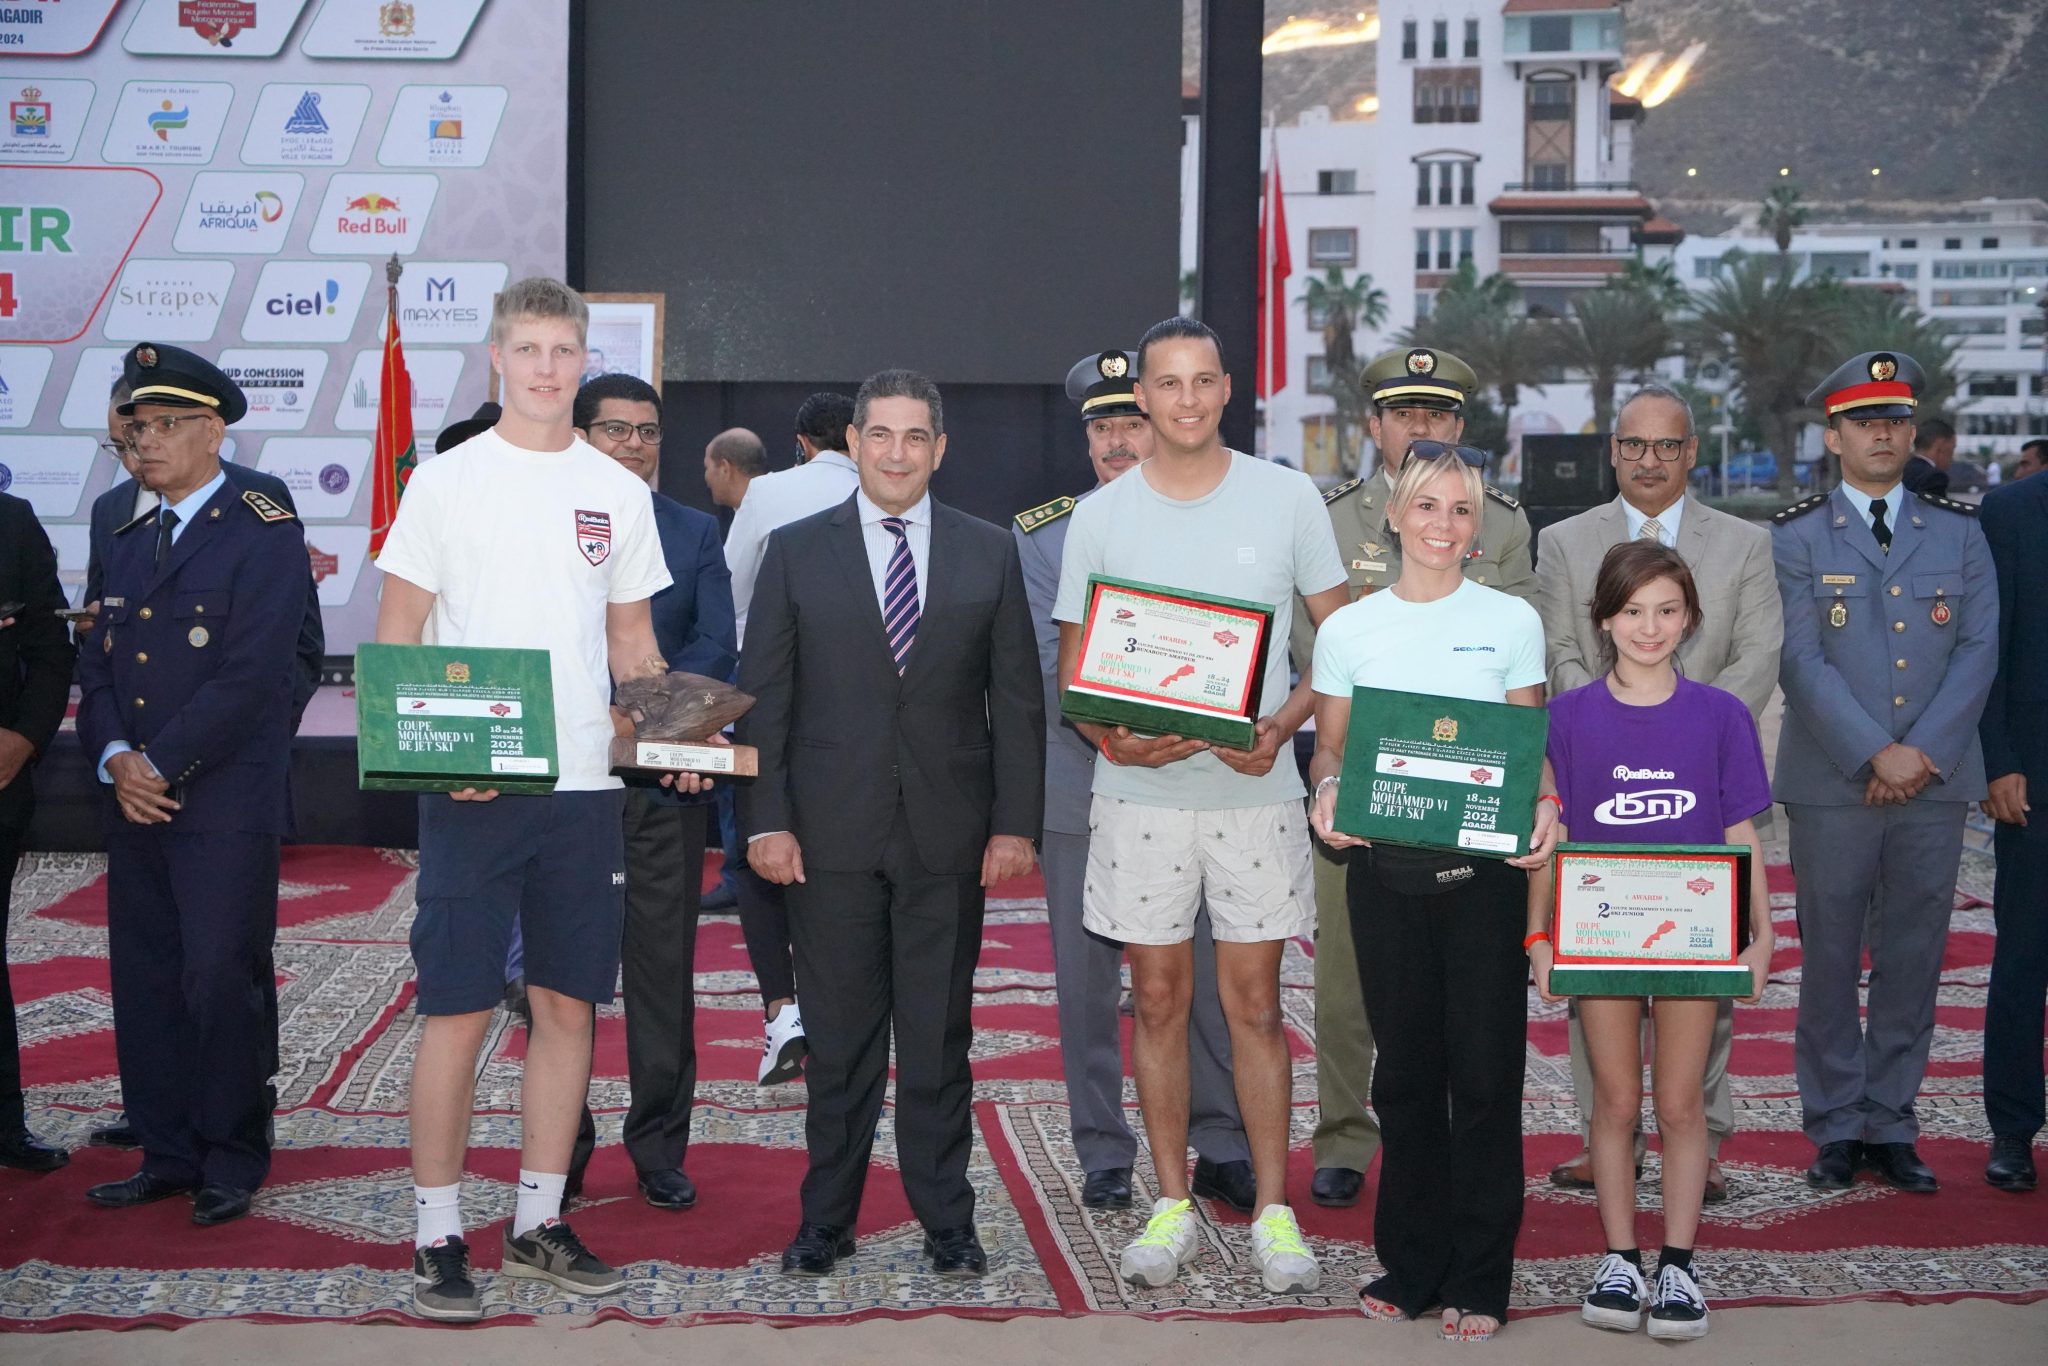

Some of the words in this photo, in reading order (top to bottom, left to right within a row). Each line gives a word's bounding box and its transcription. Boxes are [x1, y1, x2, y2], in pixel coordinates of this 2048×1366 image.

[199, 218, 258, 229] AFRIQUIA
[338, 217, 371, 233] Red
[375, 217, 407, 234] Bull
[120, 286, 220, 310] Strapex
[403, 308, 478, 321] MAXYES
[244, 368, 304, 378] CONCESSION
[1125, 637, 1137, 653] 3
[1136, 647, 1167, 657] RUNABOUT
[398, 720, 432, 731] COUPE
[490, 725, 502, 733] 18
[511, 726, 523, 735] 24
[399, 731, 460, 742] MOHAMMED
[463, 732, 474, 743] VI
[399, 741, 412, 751] DE
[414, 741, 432, 752] JET
[435, 742, 453, 752] SKI
[490, 740, 524, 750] 2024
[1372, 780, 1408, 794] COUPE
[1371, 791, 1434, 809] MOHAMMED
[1437, 799, 1448, 812] VI
[1466, 793, 1478, 802] 18
[1487, 796, 1500, 806] 24
[1369, 802, 1384, 815] DE
[1384, 805, 1404, 817] JET
[1406, 807, 1425, 820] SKI
[1465, 804, 1499, 813] NOVEMBRE
[1615, 793, 1682, 819] bnj
[1463, 810, 1496, 825] 2024
[1461, 821, 1496, 831] AGADIR
[1464, 836, 1471, 846] 3
[1436, 870, 1450, 880] PIT
[1451, 865, 1473, 876] BULL
[1598, 902, 1610, 918] 2
[1576, 929, 1621, 938] MOHAMMED
